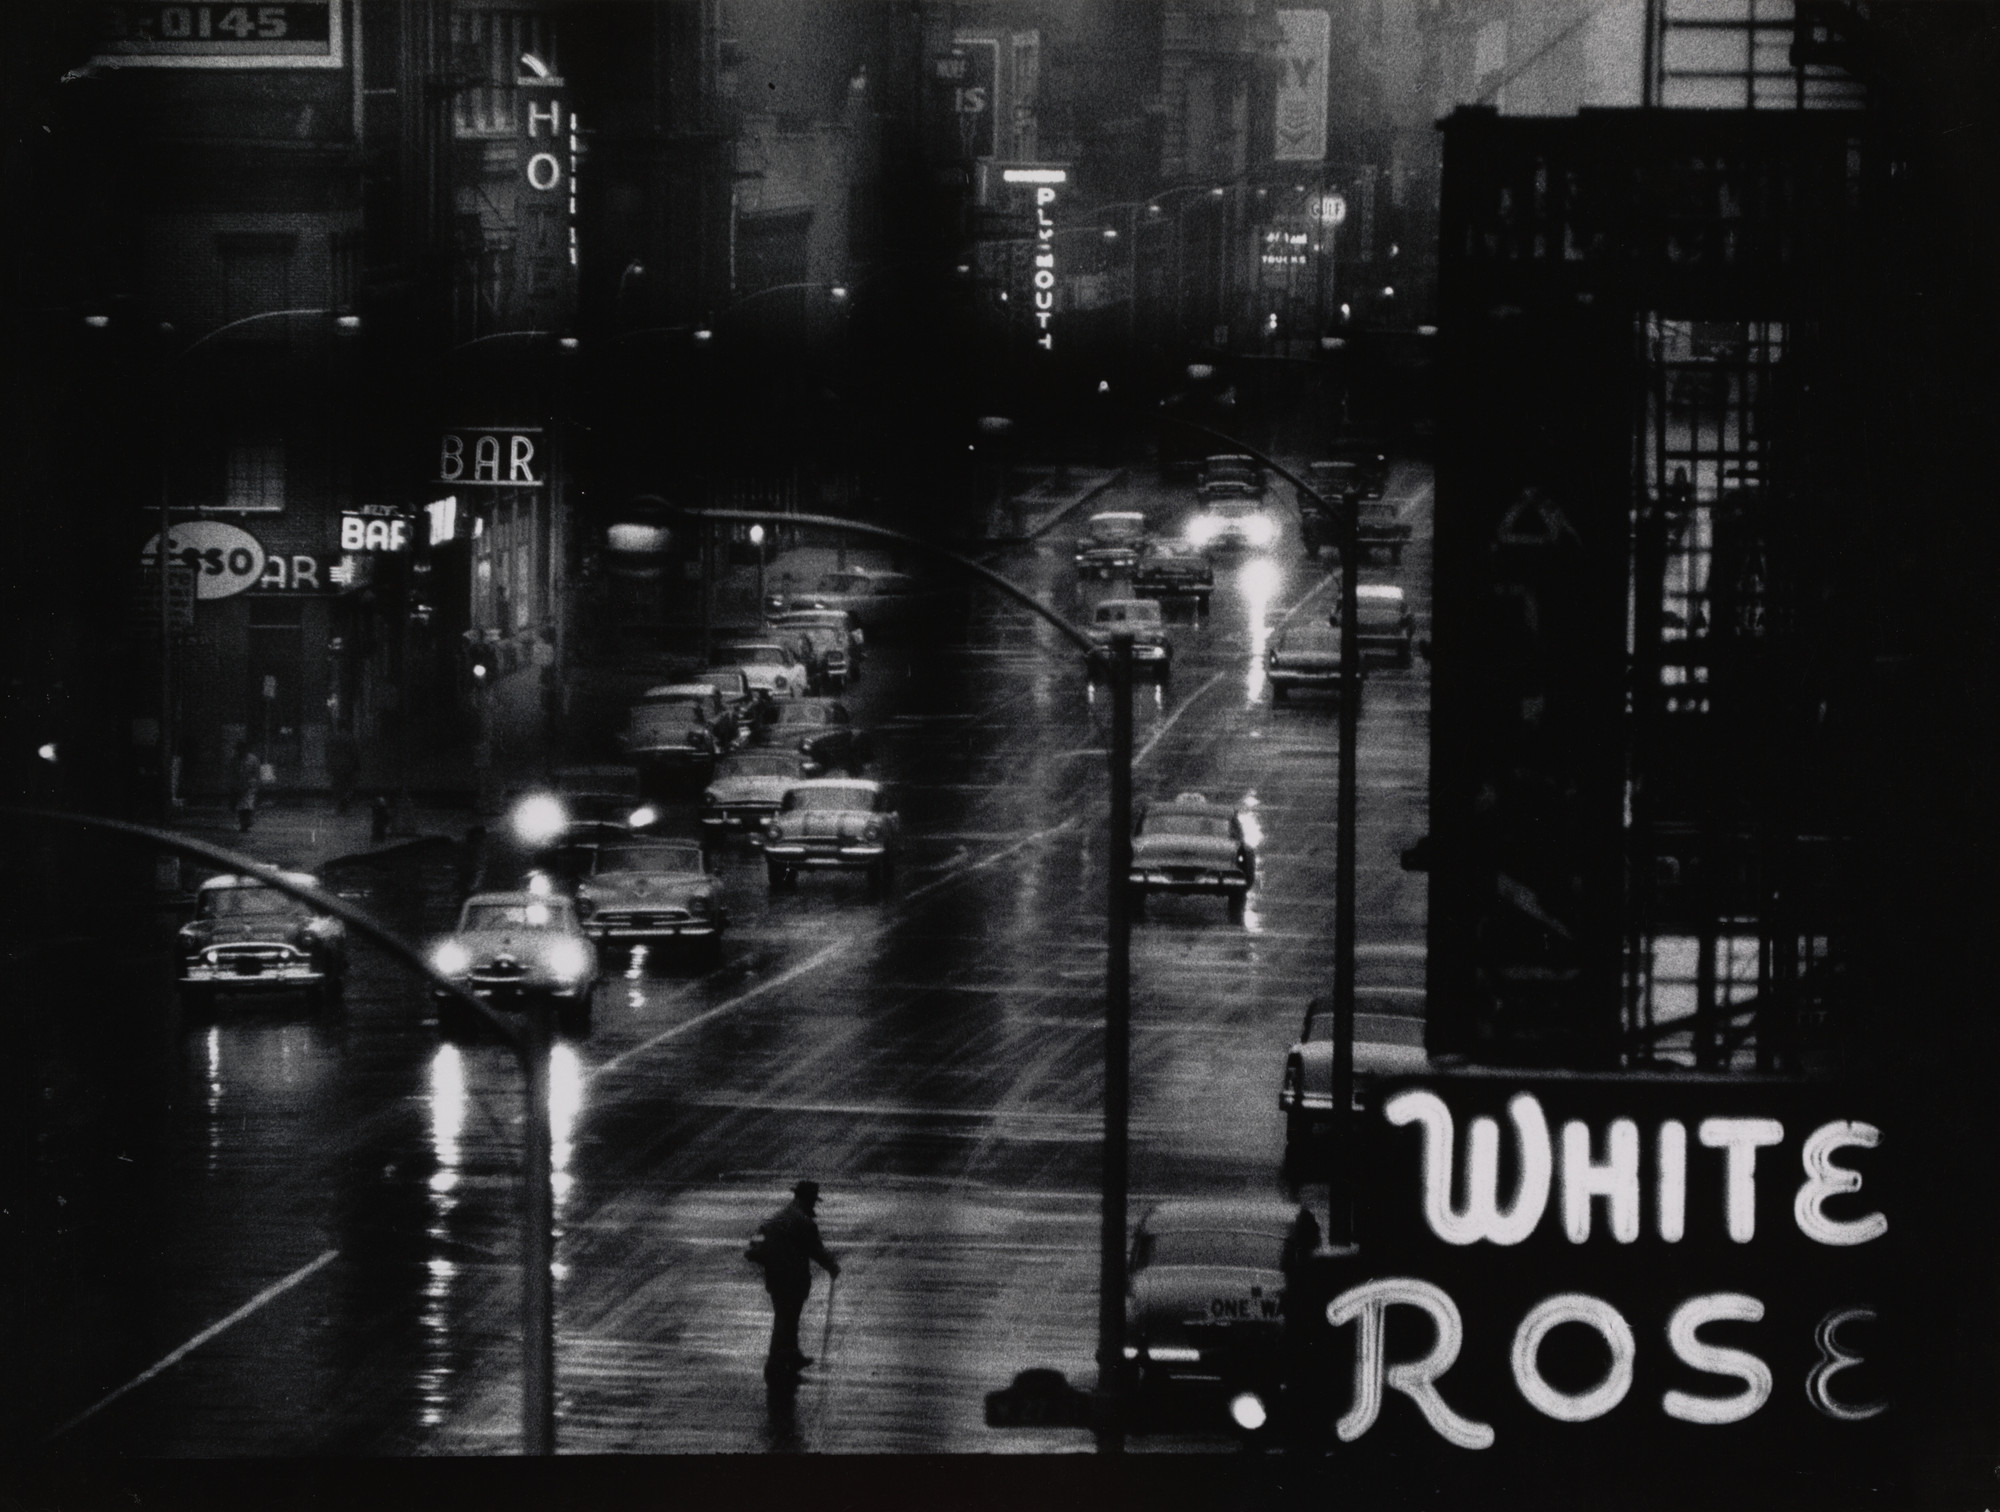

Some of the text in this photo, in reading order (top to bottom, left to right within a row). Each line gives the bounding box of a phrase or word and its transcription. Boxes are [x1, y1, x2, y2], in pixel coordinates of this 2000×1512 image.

[440, 435, 535, 481] BAR
[1385, 1088, 1888, 1246] WHITE
[1211, 1298, 1248, 1318] ONE
[1326, 1277, 1888, 1450] ROSE
